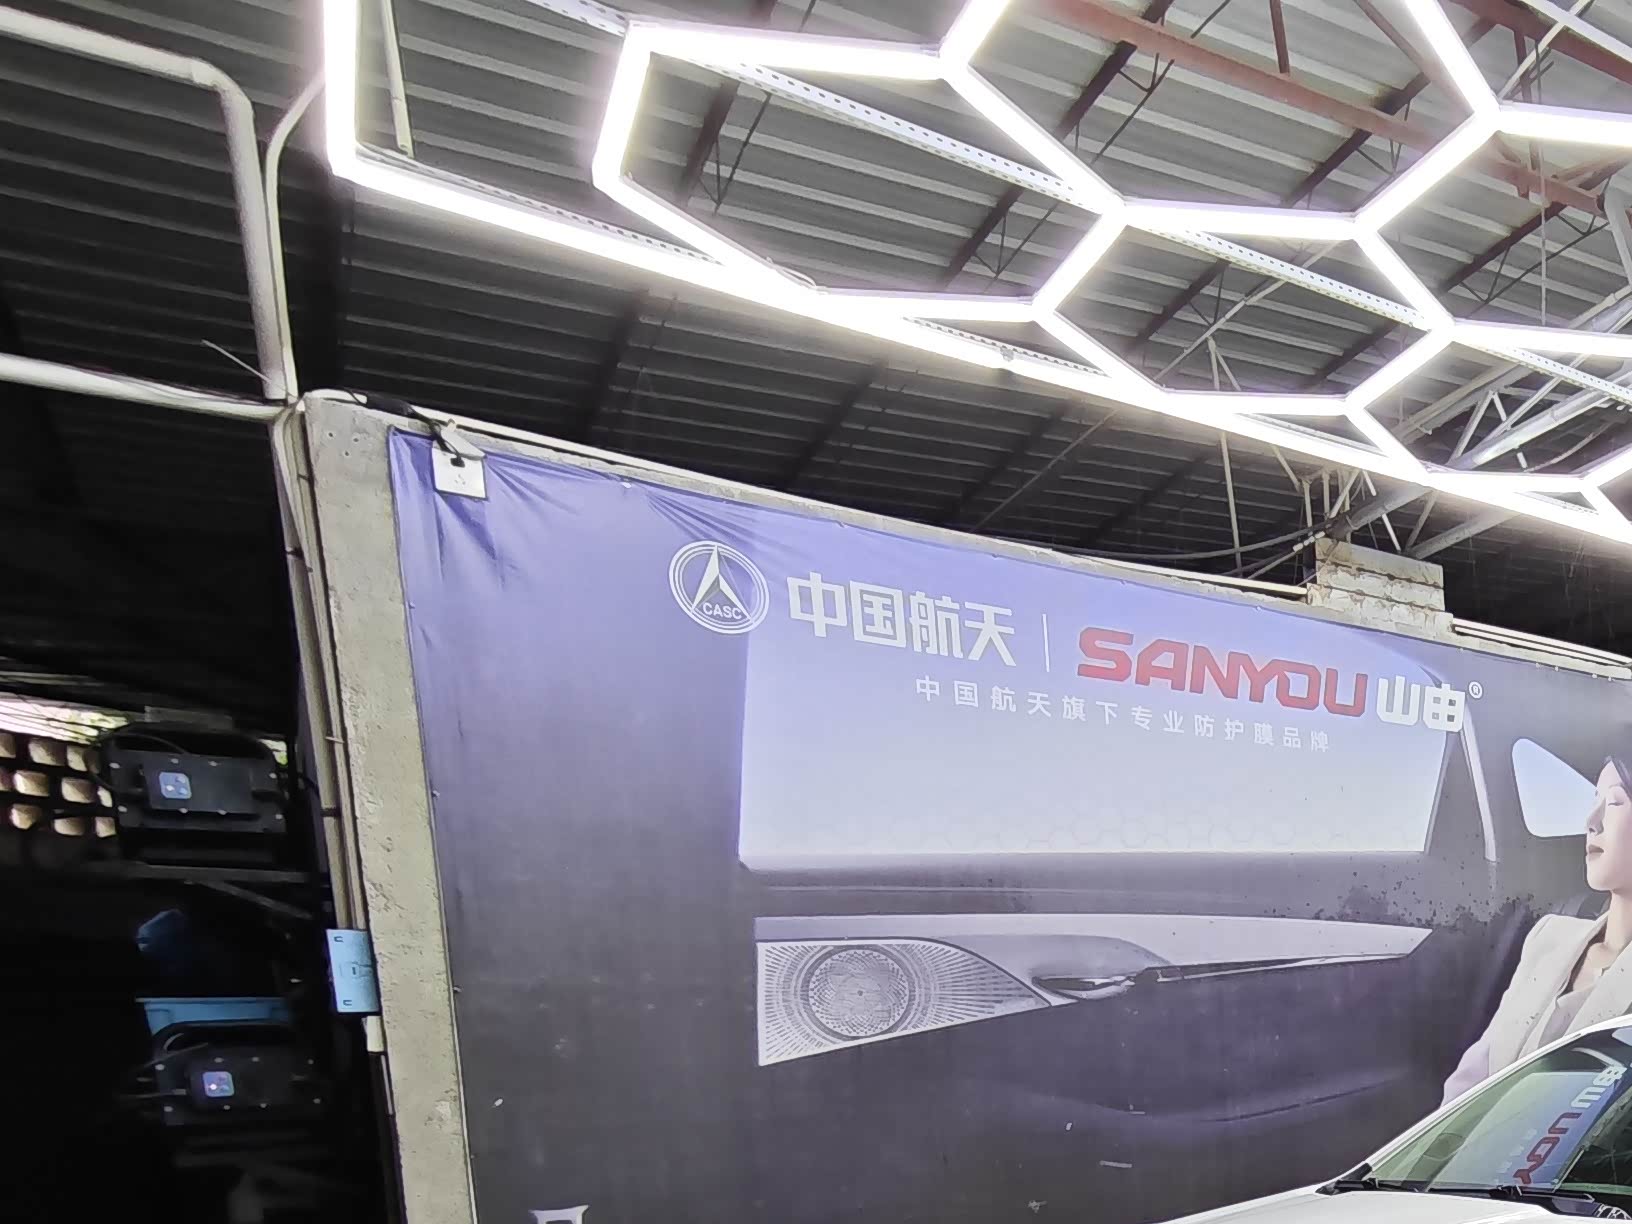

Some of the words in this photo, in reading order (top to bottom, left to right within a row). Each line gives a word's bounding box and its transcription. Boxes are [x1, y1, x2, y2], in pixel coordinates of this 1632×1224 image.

[702, 602, 743, 620] CASC
[787, 570, 1018, 668] 中国航天
[914, 674, 1331, 753] 中国航天旗下专业防护膜品牌
[1077, 626, 1369, 718] SANYOU
